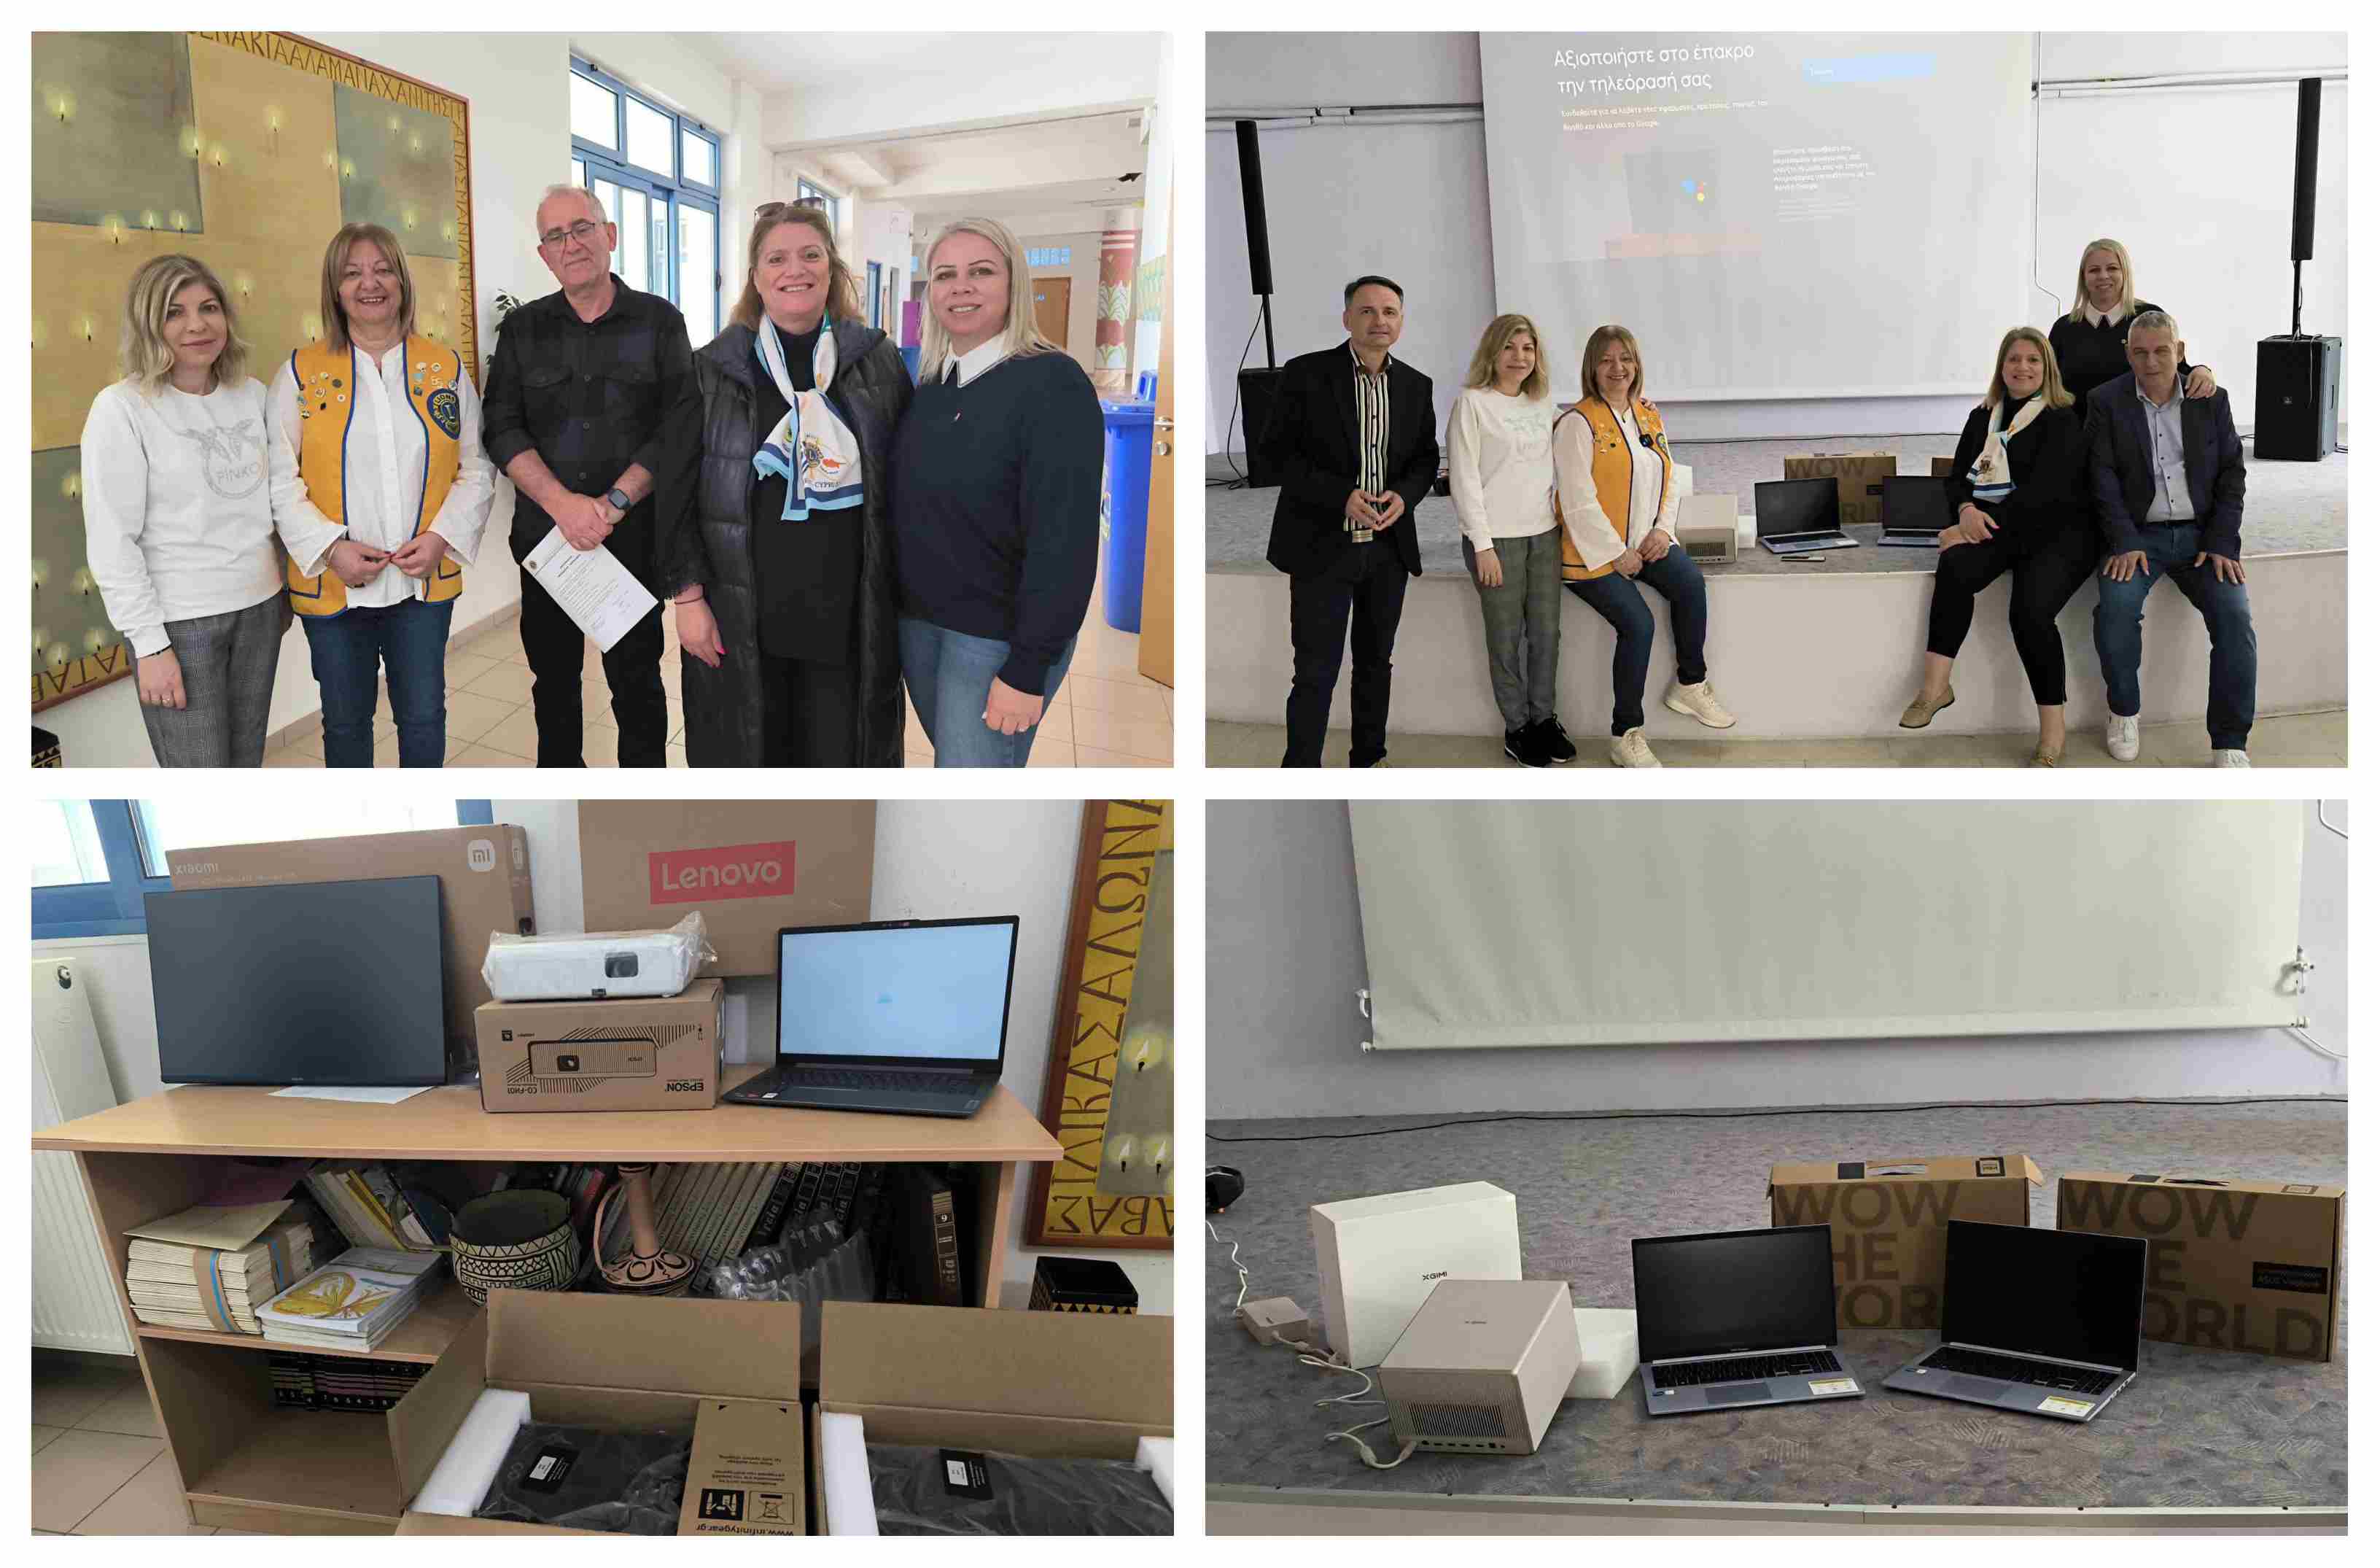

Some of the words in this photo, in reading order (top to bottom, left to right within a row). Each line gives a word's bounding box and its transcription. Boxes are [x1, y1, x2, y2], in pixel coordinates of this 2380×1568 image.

[1554, 47, 1655, 69] Αξιοποιήστε
[1660, 48, 1689, 63] στο
[1693, 44, 1754, 63] έπακρο
[1558, 79, 1584, 97] την
[1590, 71, 1679, 96] τηλεόρασή
[1681, 73, 1712, 90] σας
[661, 861, 782, 890] Lenovo
[664, 1082, 704, 1092] EPSON
[1775, 1182, 1961, 1227] WOW
[2065, 1180, 2260, 1241] WOW
[1832, 1232, 1900, 1281] HE
[1423, 1271, 1447, 1281] XGIMI
[2142, 1292, 2324, 1362] ORLD
